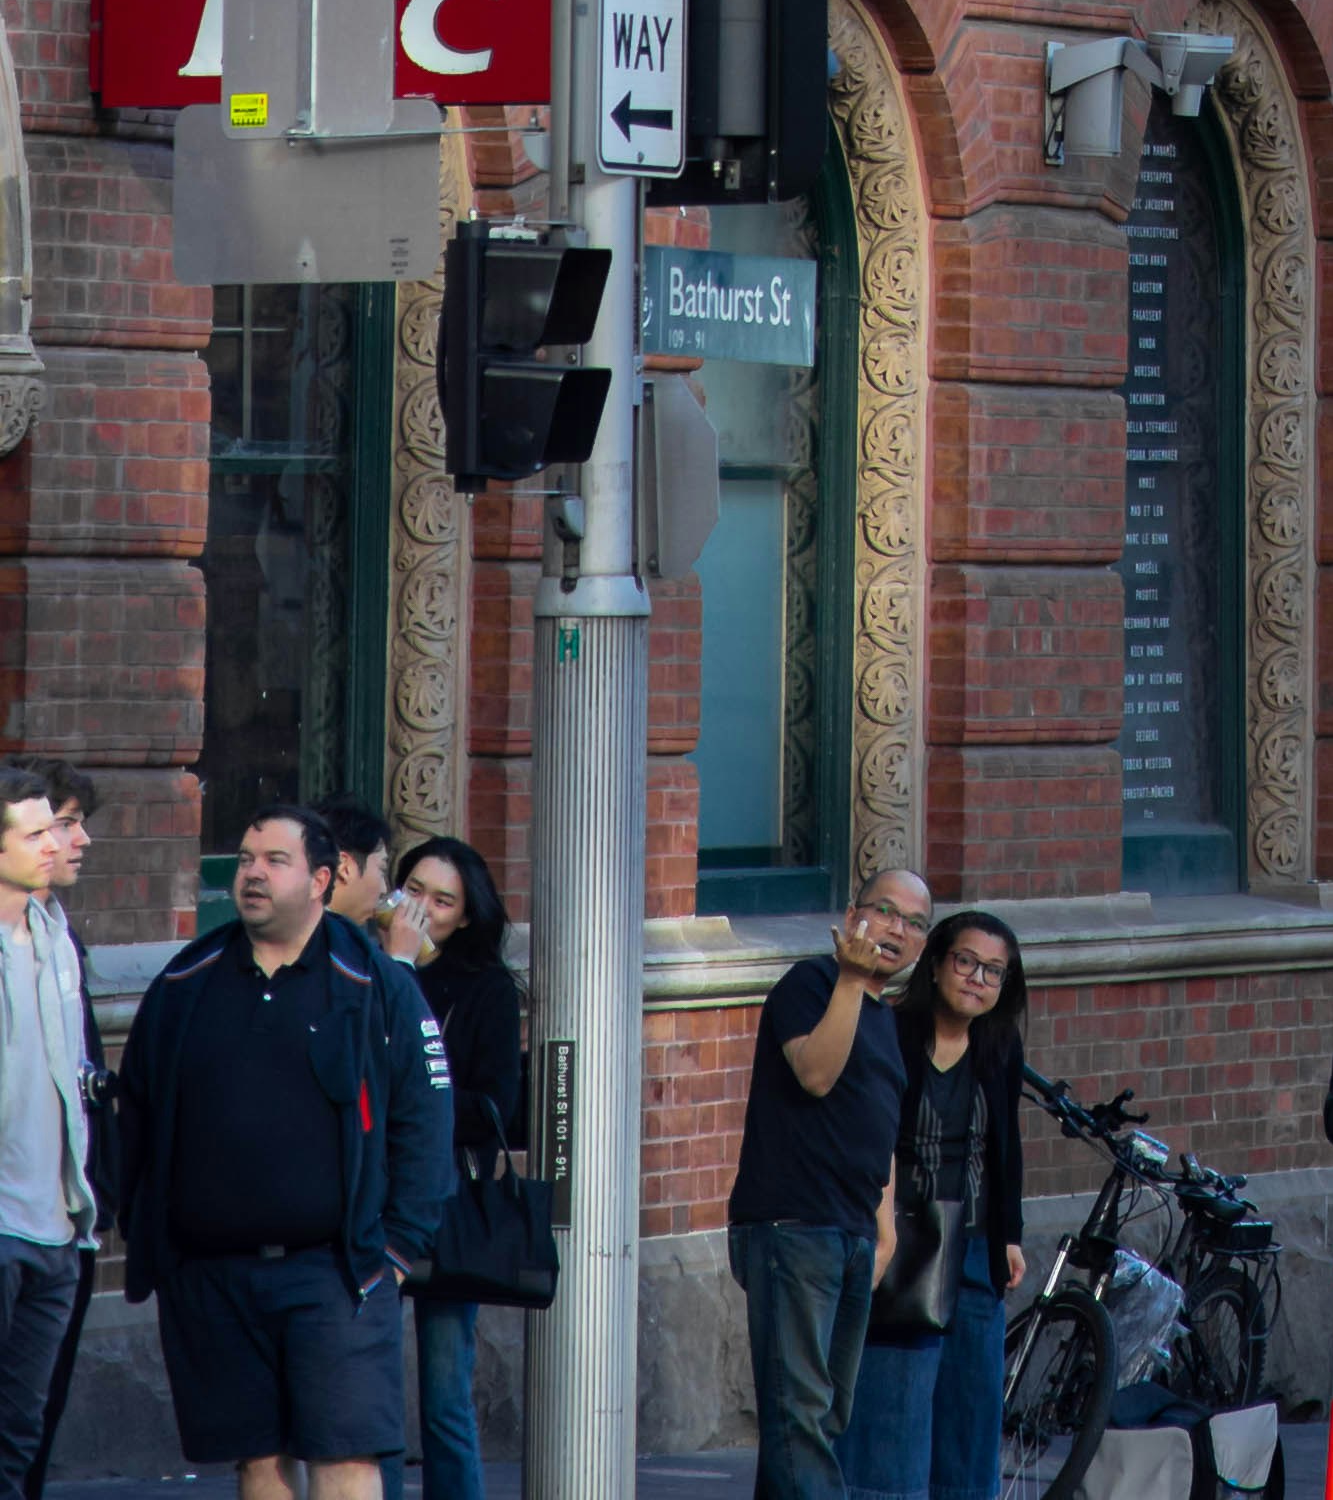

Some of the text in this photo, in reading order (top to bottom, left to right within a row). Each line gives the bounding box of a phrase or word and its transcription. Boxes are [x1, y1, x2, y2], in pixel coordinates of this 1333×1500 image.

[613, 11, 673, 73] WAY
[669, 267, 764, 324] Bathurst
[769, 276, 791, 327] St
[557, 1046, 569, 1098] Bathurst
[556, 1102, 568, 1114] St
[556, 1117, 568, 1140] 101
